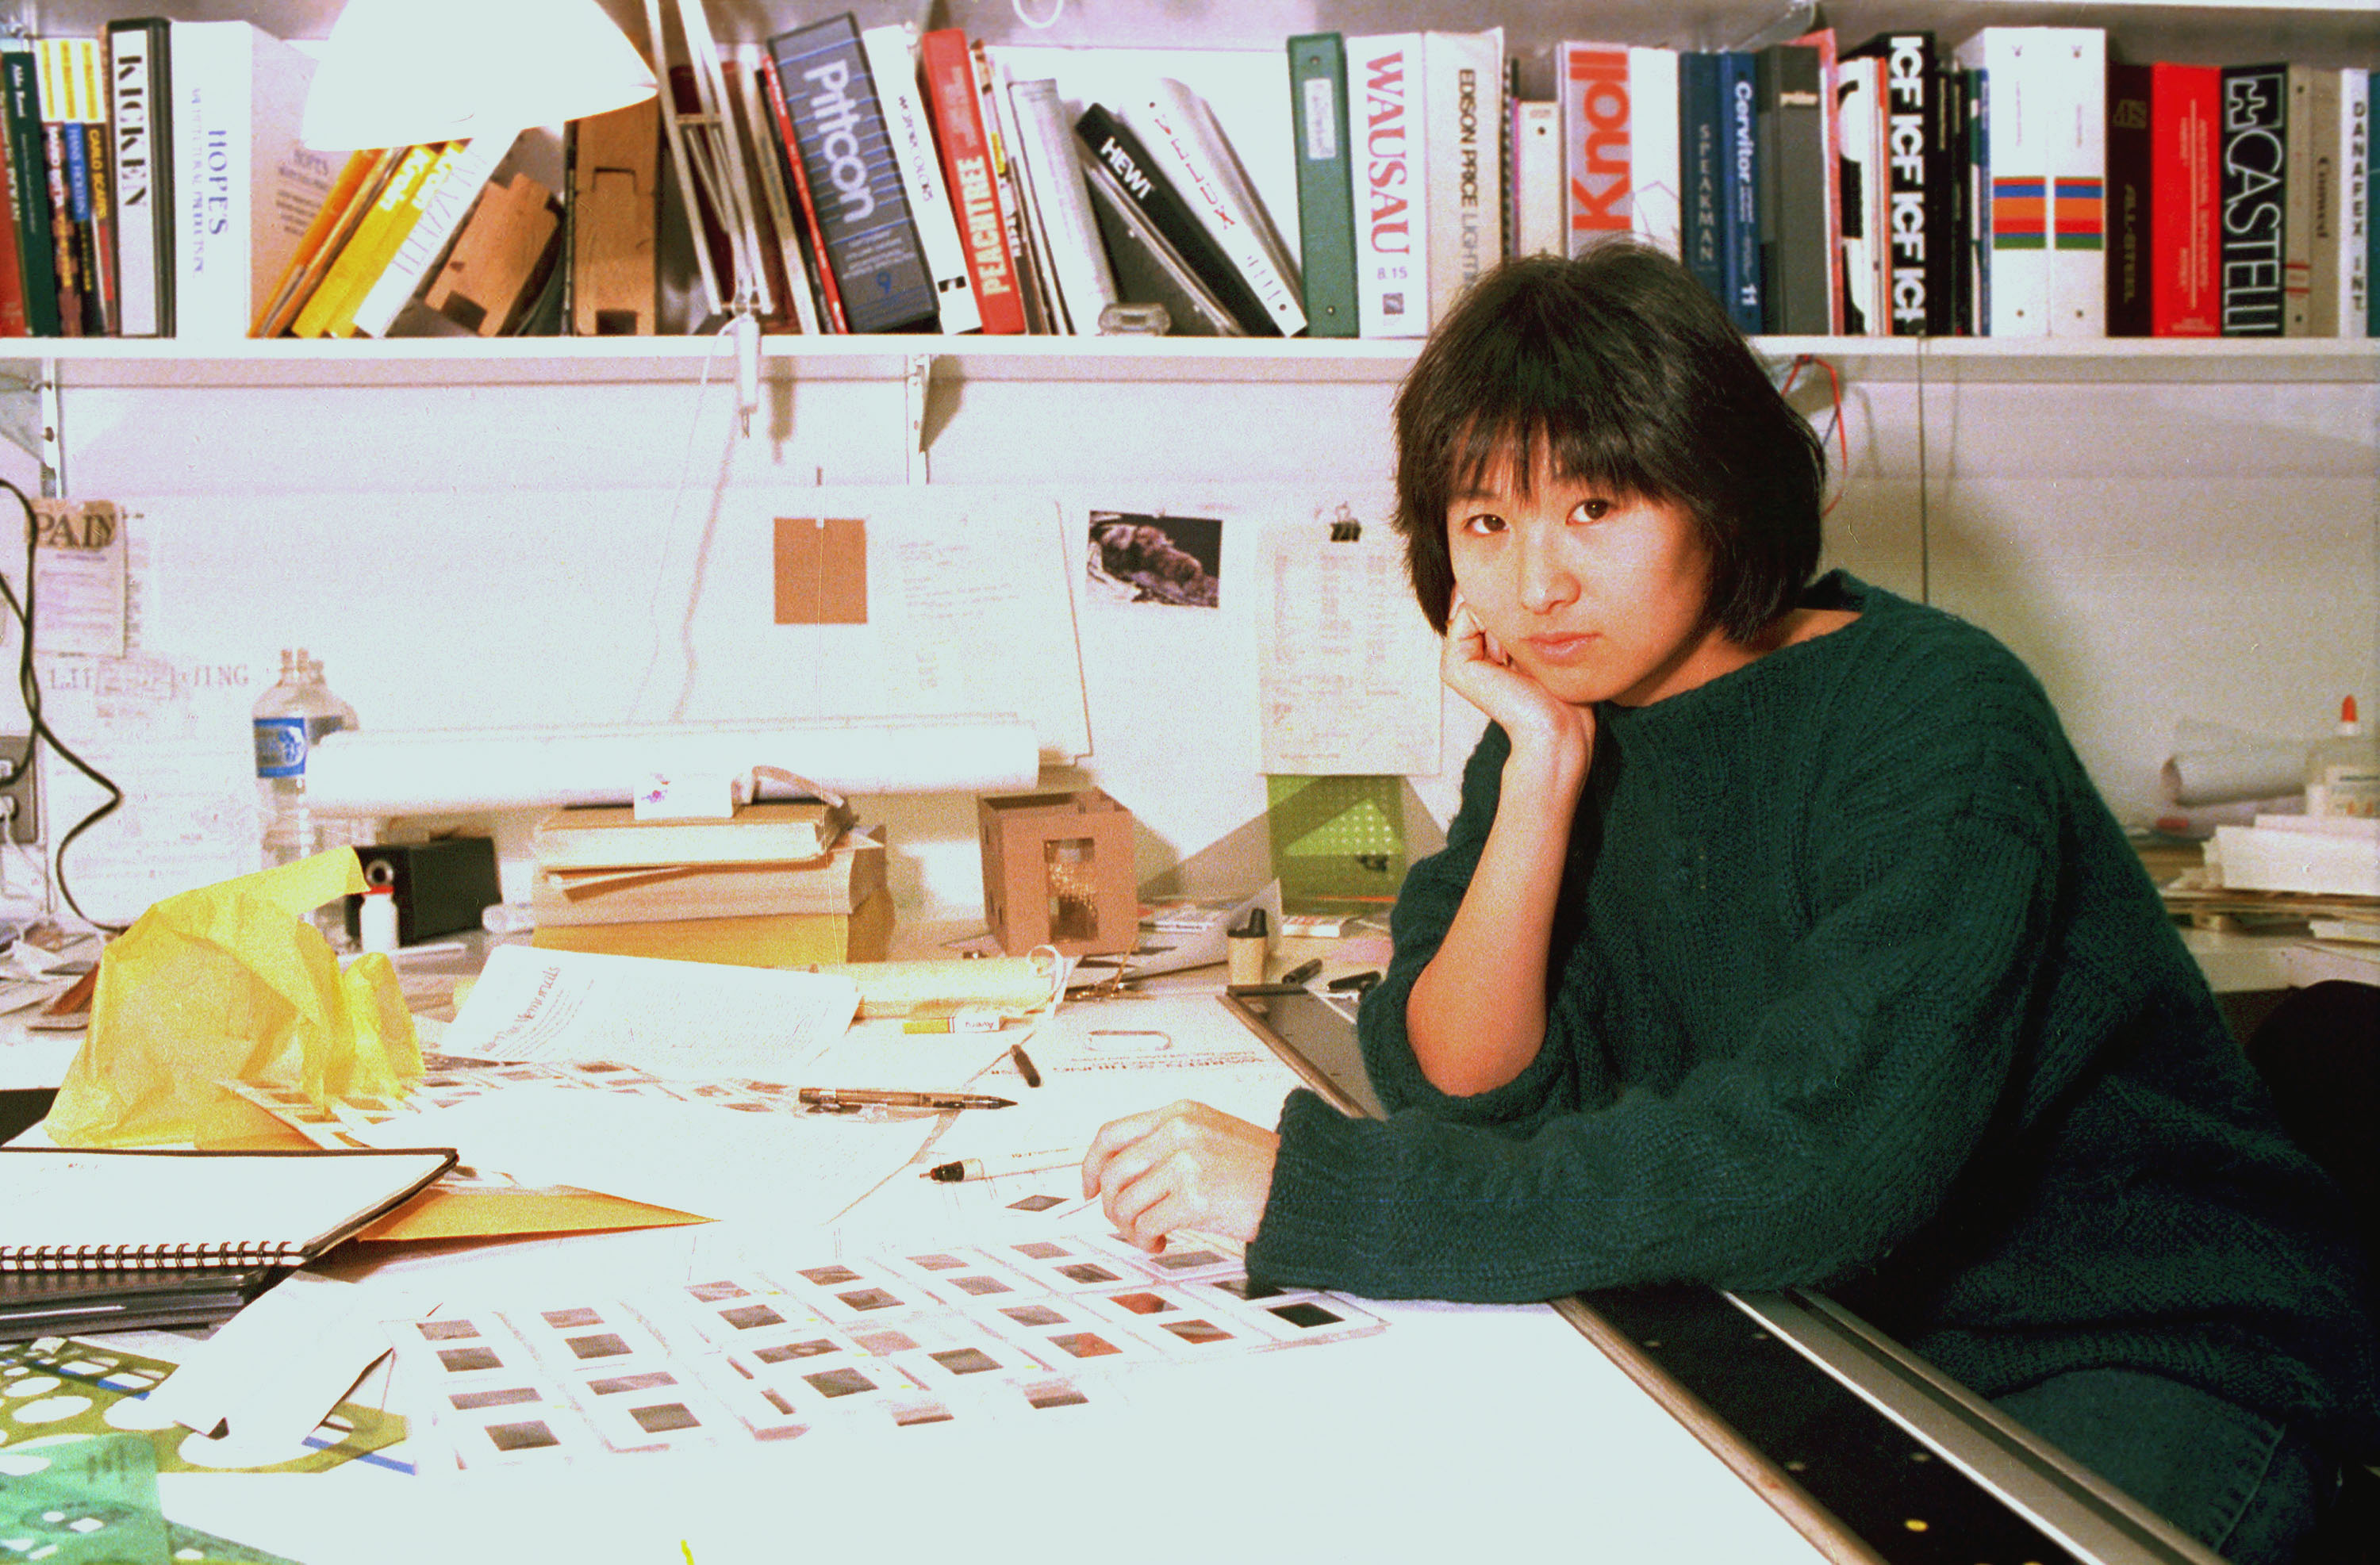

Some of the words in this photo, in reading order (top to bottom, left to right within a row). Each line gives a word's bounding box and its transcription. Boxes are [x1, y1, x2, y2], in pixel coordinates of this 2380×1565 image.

[1458, 68, 1476, 144] EDISON
[1888, 36, 1925, 108] ICF
[1100, 136, 1154, 200] HEWI
[1154, 114, 1235, 231] VELUX
[1365, 50, 1411, 255] WAUSAU
[1461, 148, 1479, 208] PRICE
[1568, 50, 1632, 231] Knoll
[1733, 81, 1756, 182] Cervitor
[1890, 113, 1925, 186] ICF
[956, 155, 1012, 297] PEACHTREE
[1698, 124, 1715, 262] SPEAKMAN
[1891, 191, 1926, 262] ICF
[2224, 128, 2283, 332] CASTELLI
